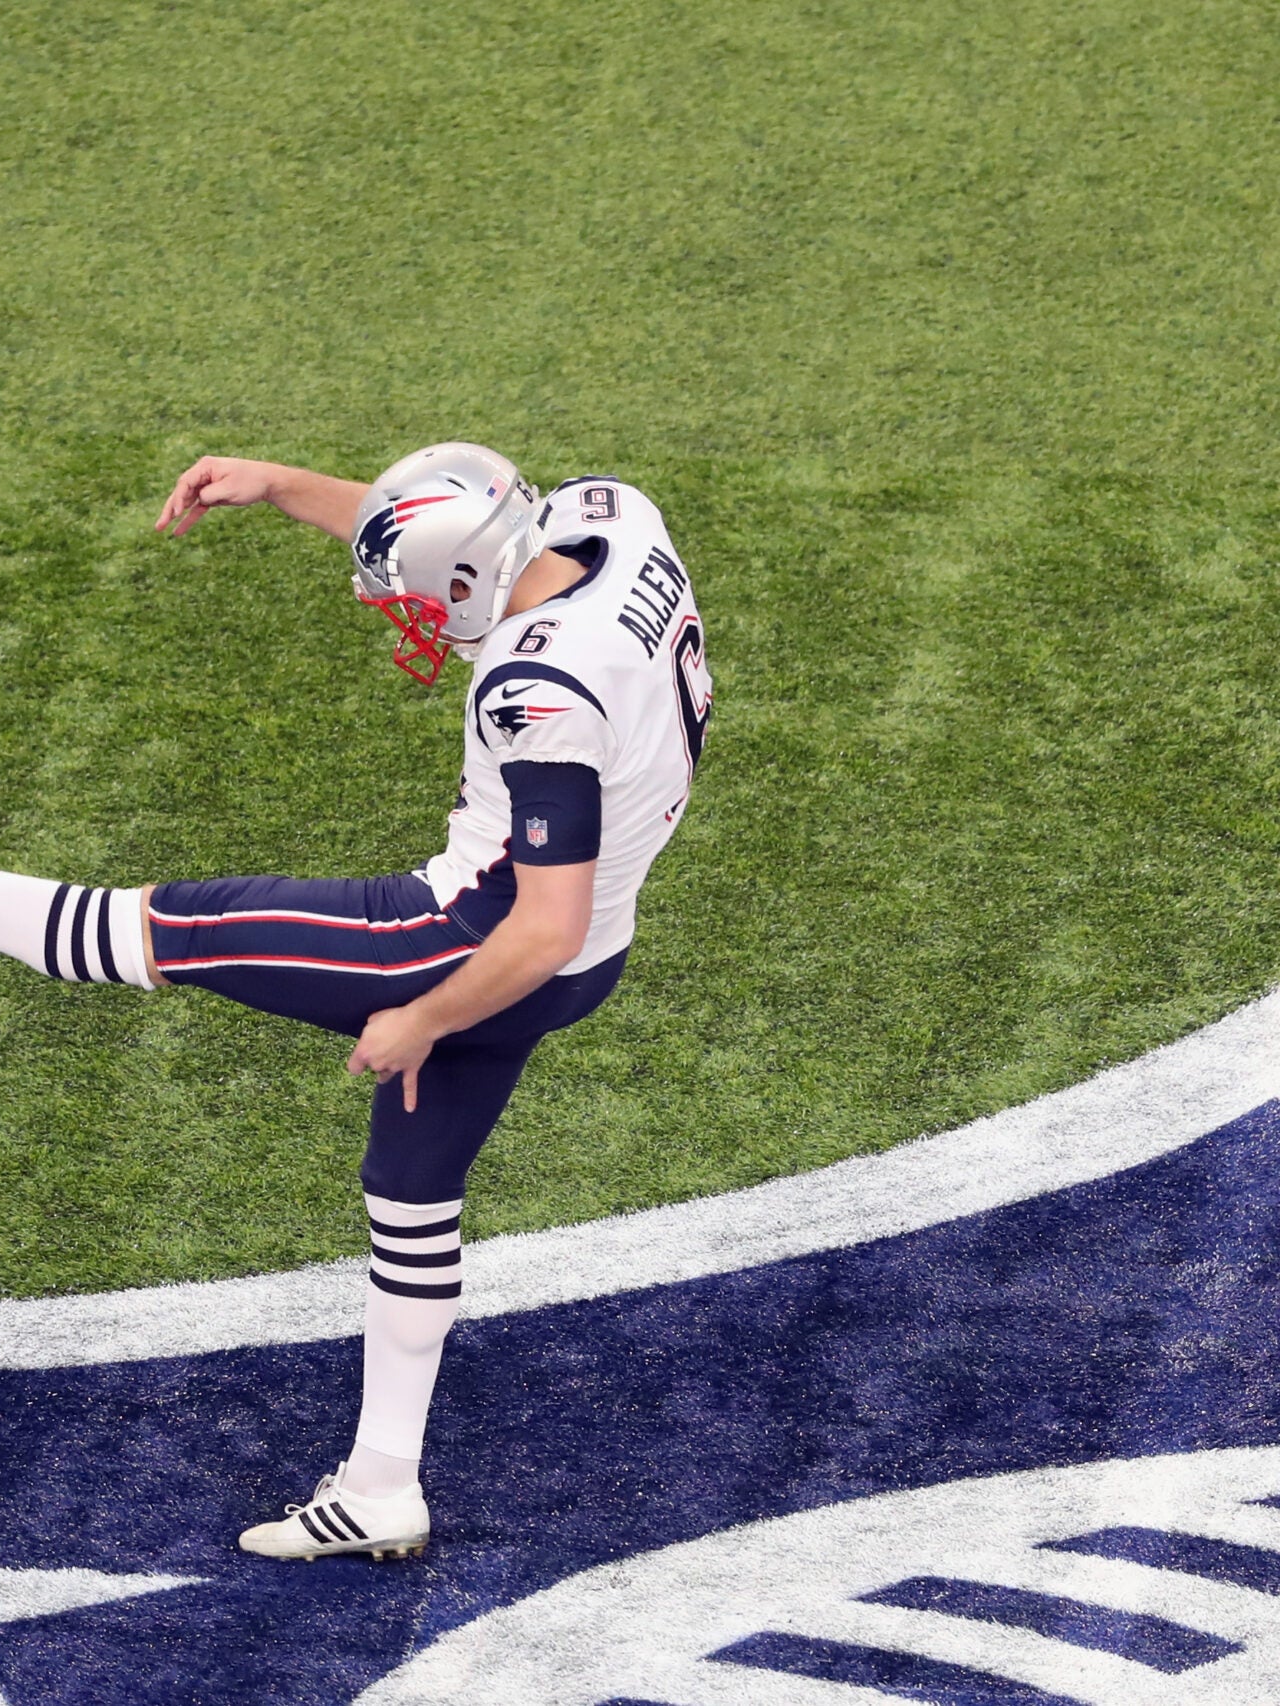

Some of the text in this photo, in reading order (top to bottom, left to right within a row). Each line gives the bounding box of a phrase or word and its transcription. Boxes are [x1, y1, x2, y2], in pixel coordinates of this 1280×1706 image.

[516, 481, 534, 504] 6
[617, 546, 687, 661] ALLEN
[509, 618, 561, 656] 6
